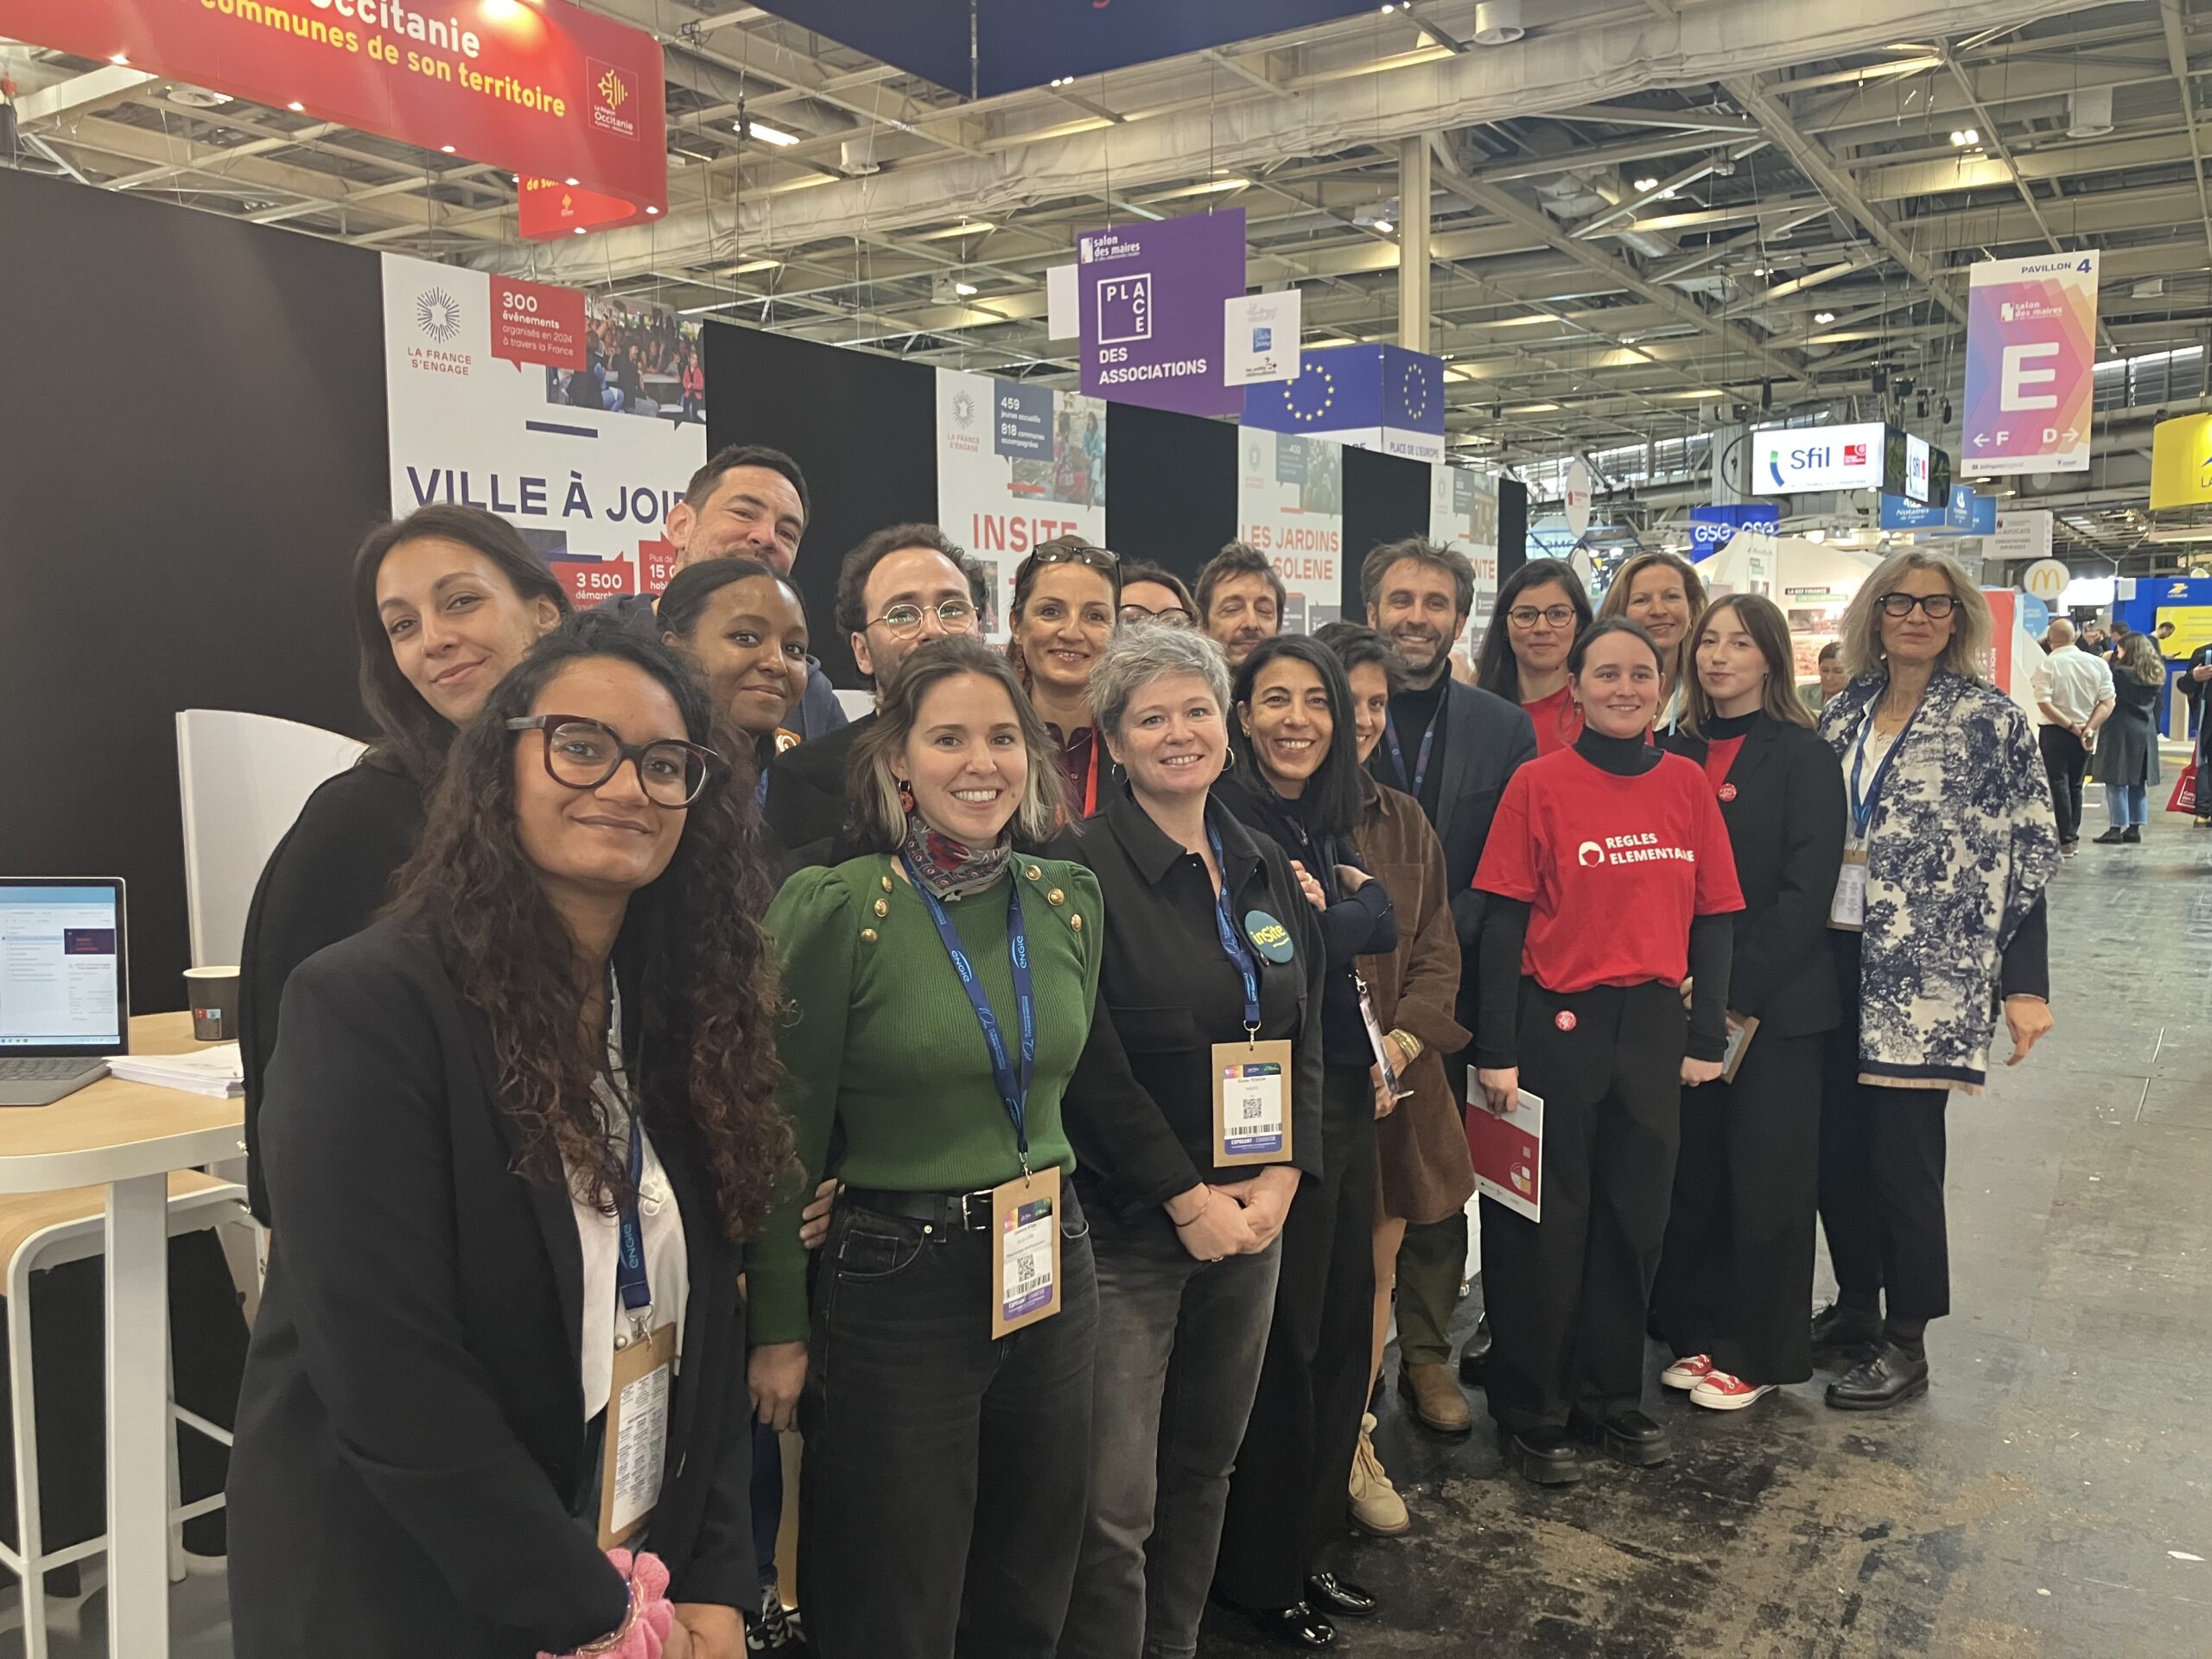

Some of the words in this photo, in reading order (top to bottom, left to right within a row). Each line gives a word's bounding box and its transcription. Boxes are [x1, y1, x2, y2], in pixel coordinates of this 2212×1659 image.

[309, 0, 480, 58] ccitanie
[367, 35, 399, 65] de
[407, 51, 451, 82] son
[458, 61, 566, 118] territoire
[594, 111, 634, 131] Occitanie
[1094, 235, 1118, 248] salon
[1094, 246, 1109, 257] des
[1111, 242, 1141, 255] maires
[2021, 263, 2072, 274] PAVILLON
[2076, 258, 2092, 273] 4
[503, 291, 537, 312] 300
[553, 333, 573, 343] 2024
[408, 346, 423, 357] LA
[426, 350, 472, 365] FRANCE
[548, 344, 575, 356] France
[1099, 347, 1128, 364] DES
[411, 359, 469, 375] S'ENGAGE
[1098, 359, 1208, 385] ASSOCIATIONS
[2000, 342, 2059, 411] E
[1001, 397, 1020, 410] 459
[1001, 423, 1017, 436] 818
[2043, 429, 2057, 443] D
[1996, 431, 2009, 446] F
[1389, 442, 1406, 454] PLACE
[1408, 445, 1414, 455] DE
[1790, 447, 1830, 469] Sfil
[406, 466, 547, 515] VILLE
[563, 470, 593, 518] À
[1242, 524, 1271, 548] LES
[1276, 528, 1338, 552] JARDINS
[649, 554, 664, 563] Plus
[649, 564, 665, 578] 15
[576, 572, 586, 588] 3
[590, 573, 622, 588] 500
[1605, 833, 1658, 849] REGLES
